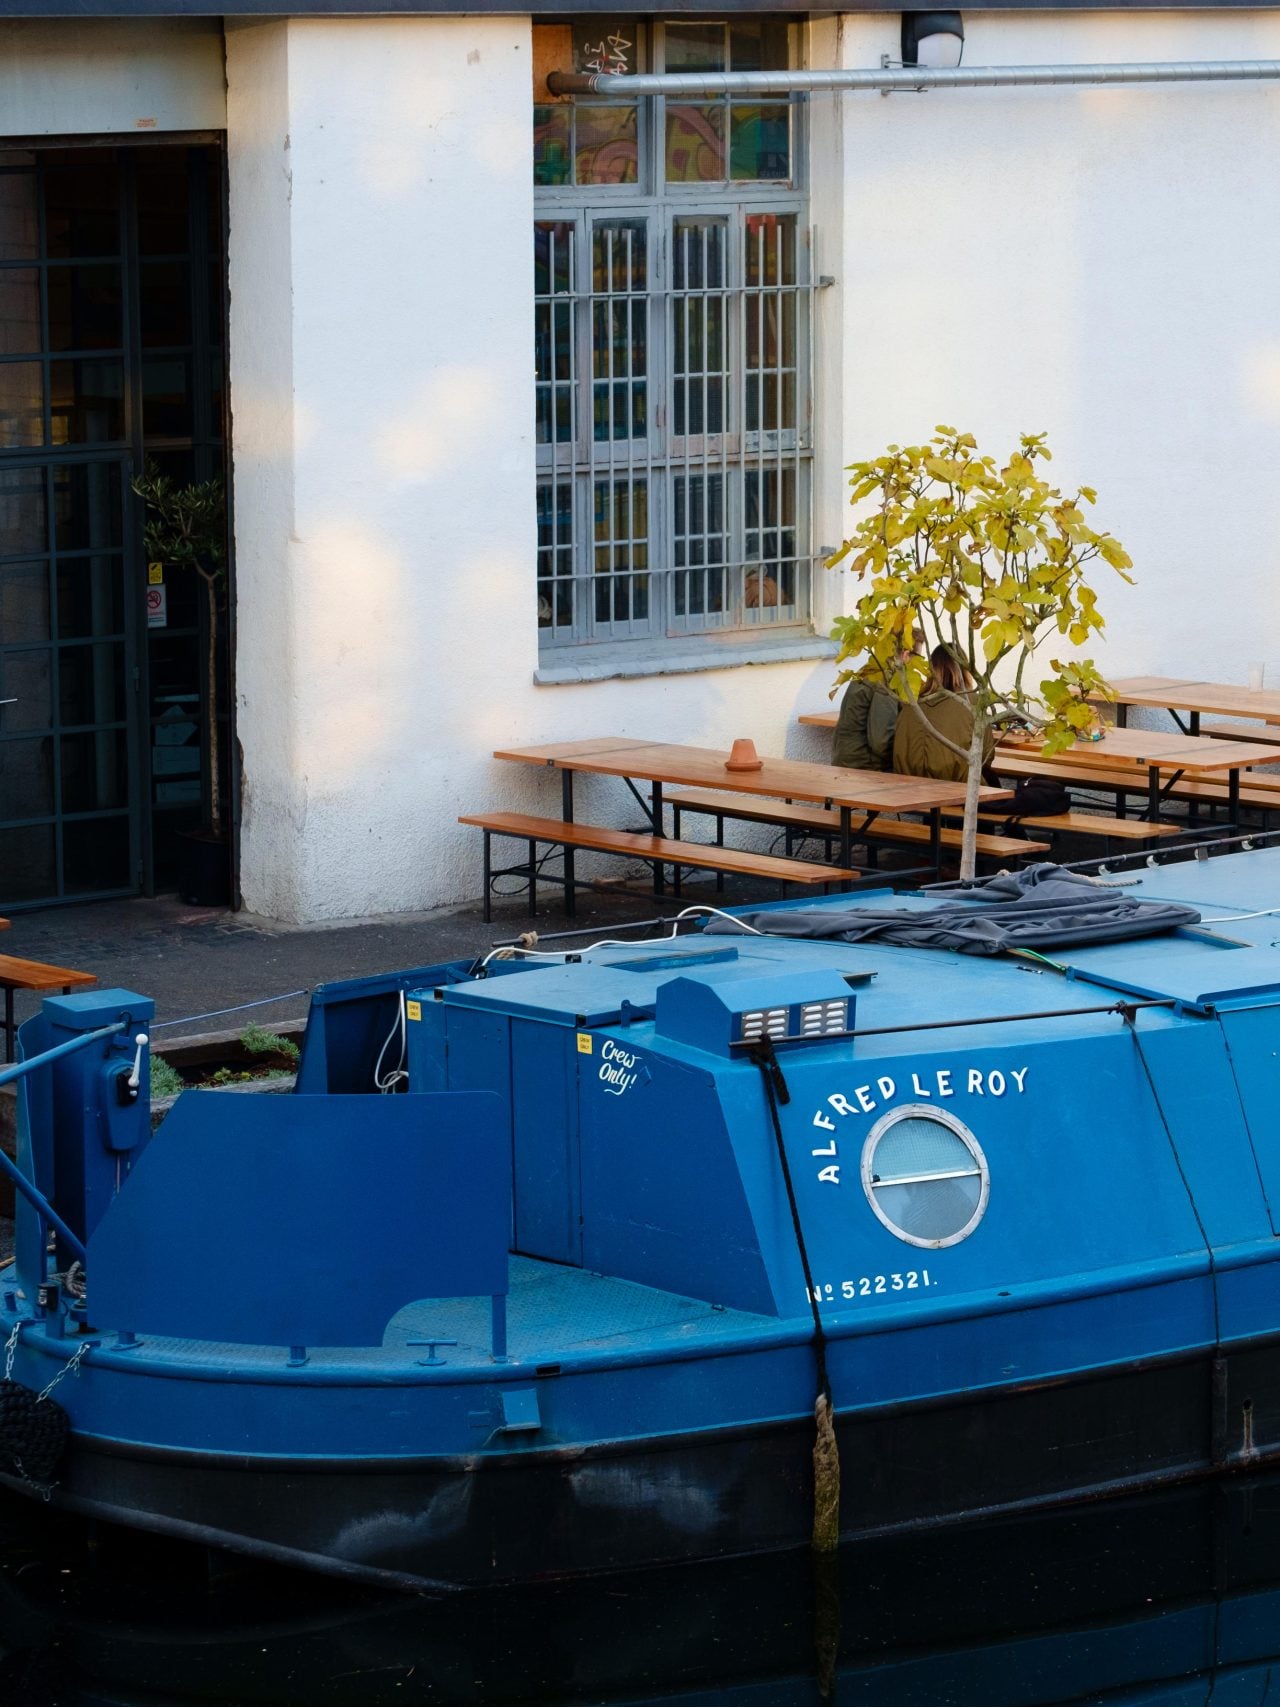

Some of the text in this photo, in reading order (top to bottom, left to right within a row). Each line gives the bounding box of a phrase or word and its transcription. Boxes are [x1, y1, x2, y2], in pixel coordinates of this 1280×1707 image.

[601, 1040, 643, 1069] Crew
[599, 1062, 638, 1096] Only!
[811, 1067, 1029, 1184] ALFRED LE ROY
